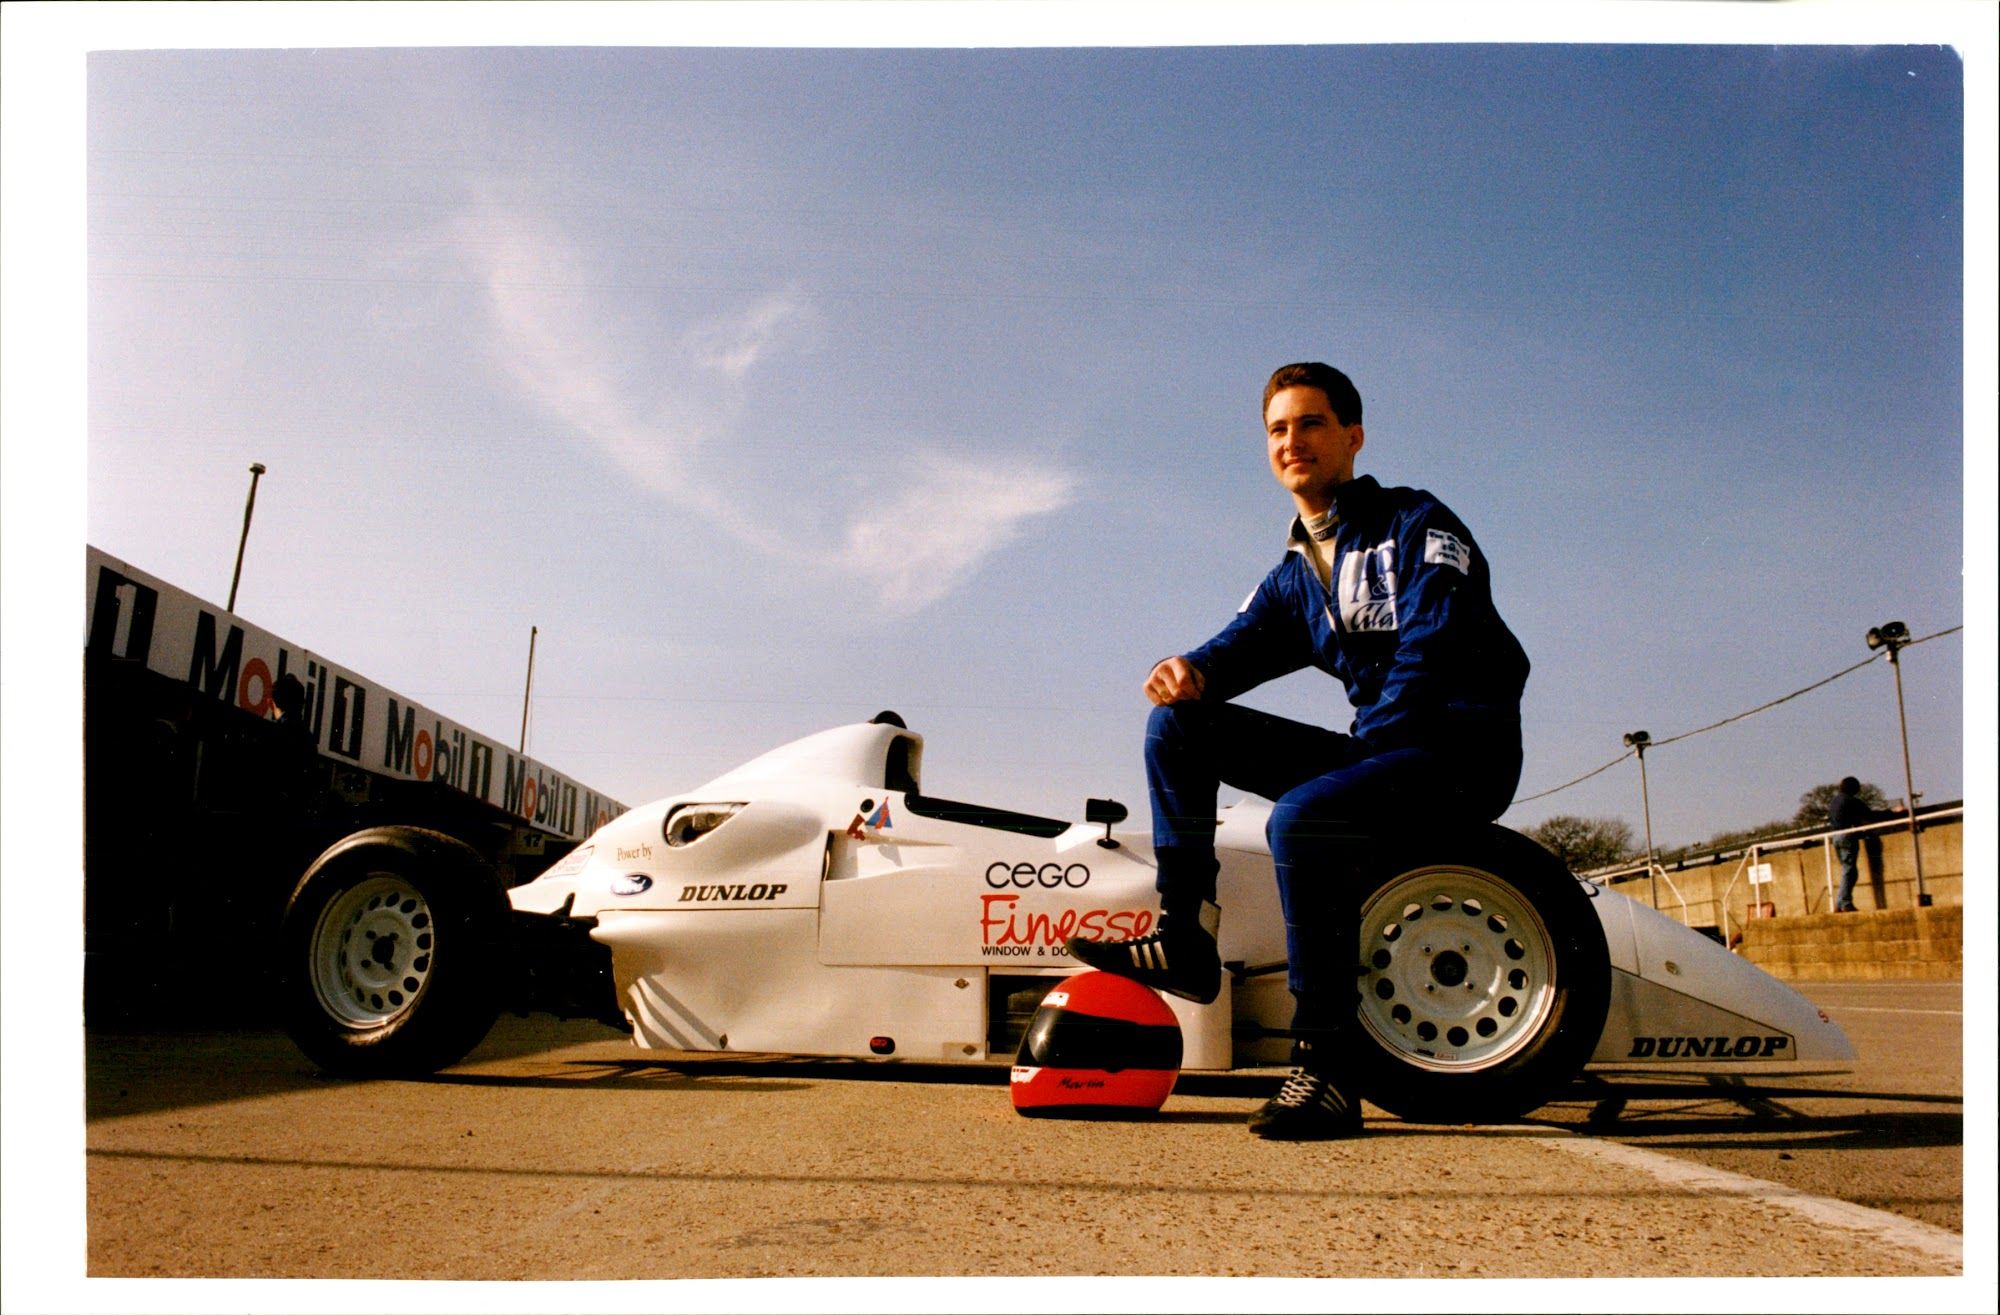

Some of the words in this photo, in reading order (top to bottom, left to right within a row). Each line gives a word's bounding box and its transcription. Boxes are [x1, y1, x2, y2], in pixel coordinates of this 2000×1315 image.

[384, 697, 466, 790] Mobil
[503, 752, 561, 828] Mobil
[616, 847, 641, 861] Power
[641, 842, 653, 861] by
[677, 883, 788, 903] DUNLOP
[979, 894, 1154, 946] Finesse
[981, 945, 1032, 957] WINDOW
[1036, 945, 1046, 957] &
[1051, 945, 1070, 957] DO
[1628, 1036, 1789, 1058] DUNLOP
